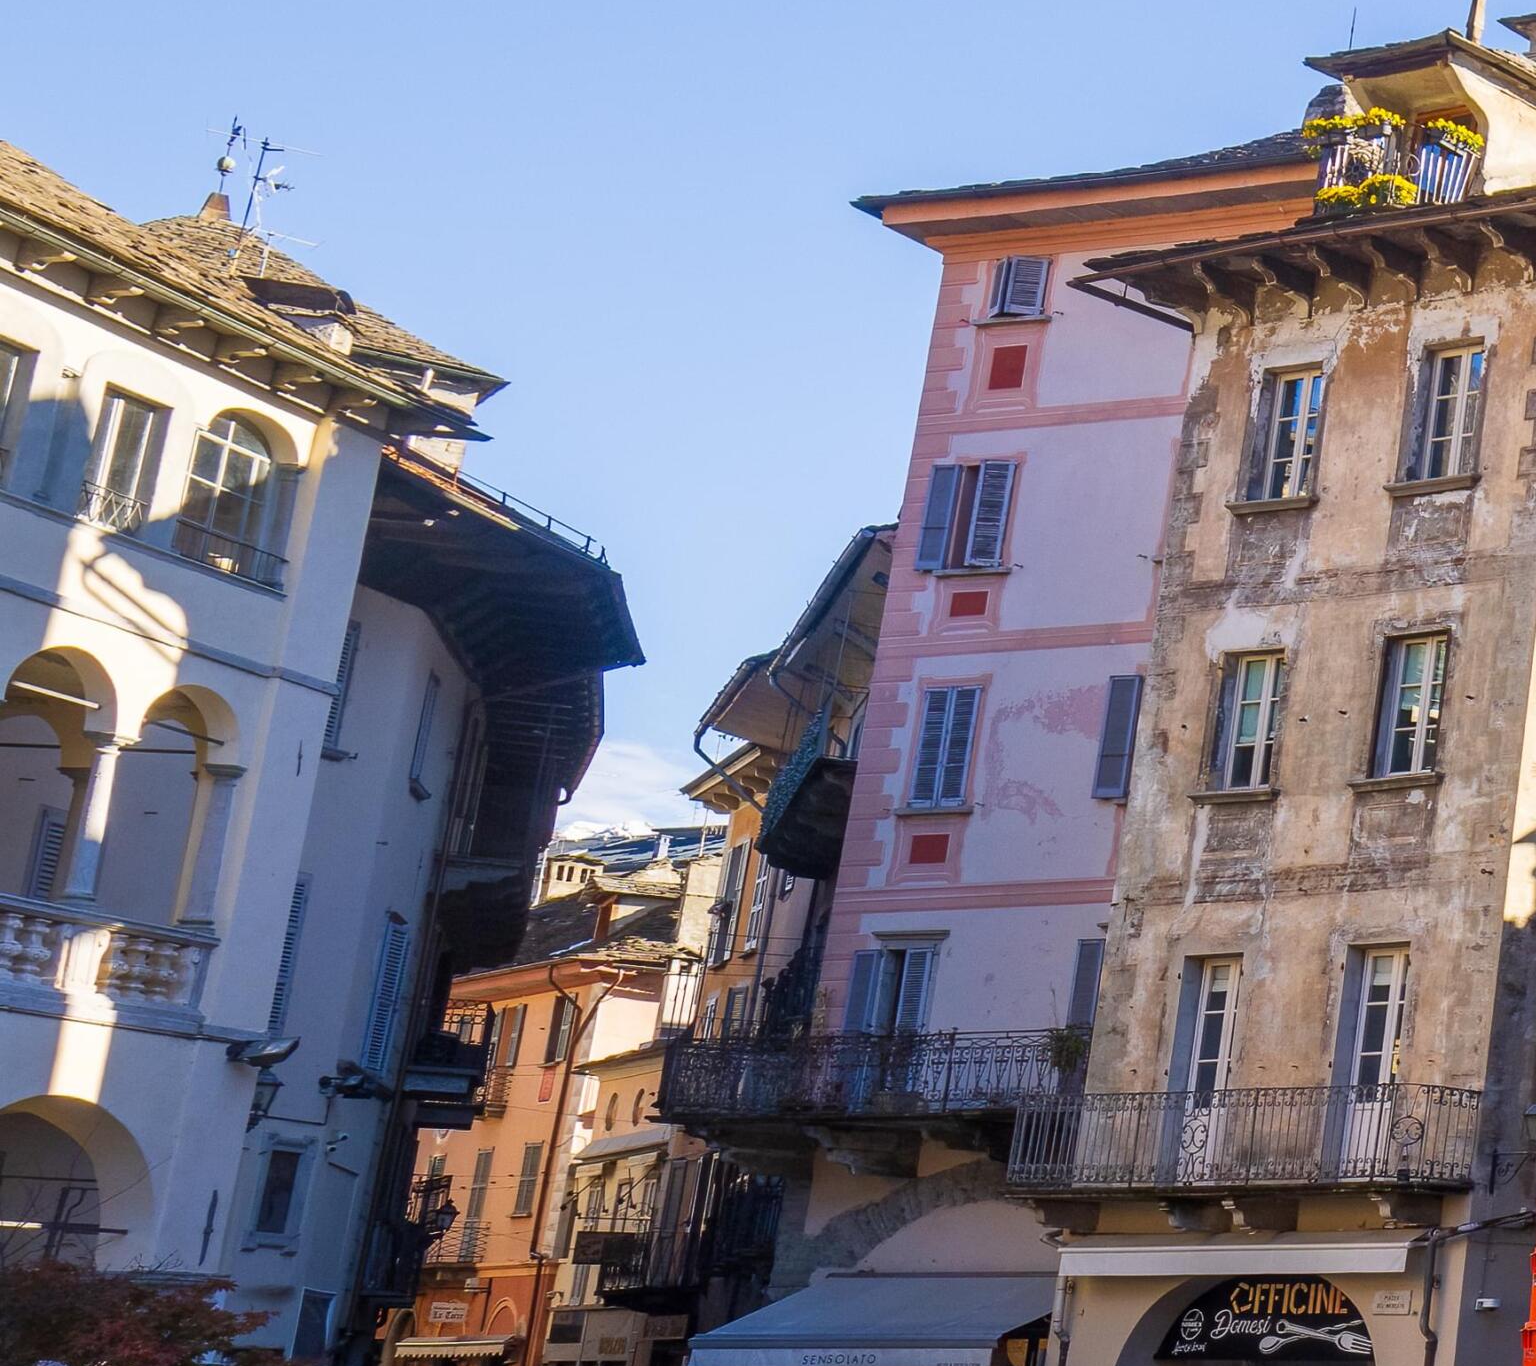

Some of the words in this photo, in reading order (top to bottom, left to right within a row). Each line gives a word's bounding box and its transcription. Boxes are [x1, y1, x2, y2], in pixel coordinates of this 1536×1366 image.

[1230, 1282, 1350, 1315] OFFICINE
[1210, 1309, 1271, 1339] Domesi
[802, 1354, 876, 1366] SENSOLATO
